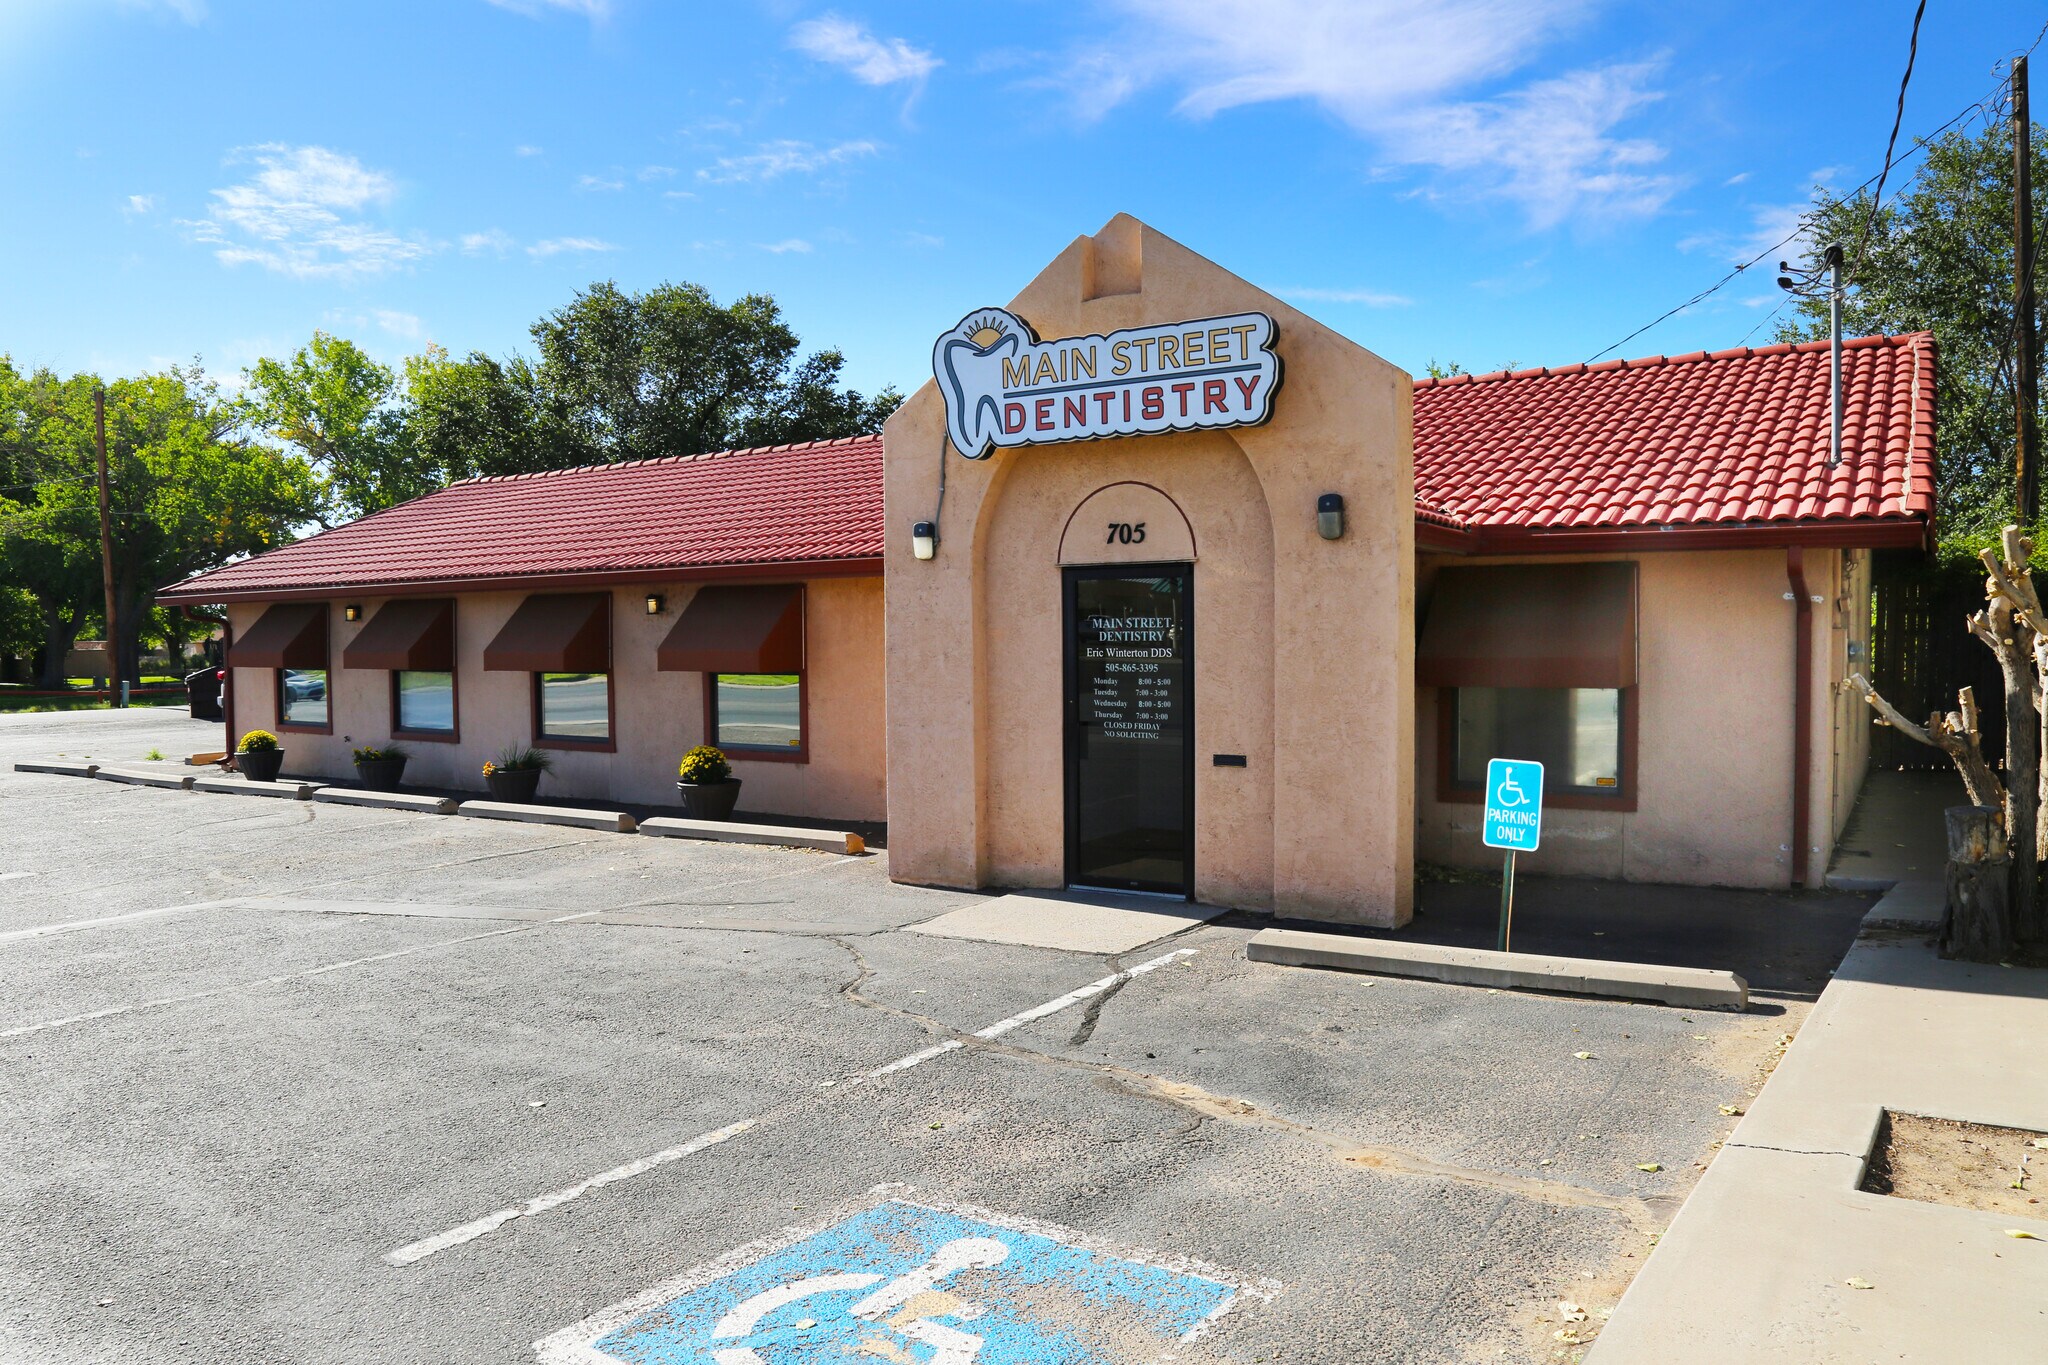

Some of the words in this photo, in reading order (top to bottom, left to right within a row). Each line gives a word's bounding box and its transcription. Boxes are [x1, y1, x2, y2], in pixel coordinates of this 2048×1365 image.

[1002, 345, 1096, 389] MAIN
[1111, 324, 1257, 375] STREET
[1004, 375, 1261, 434] DENTISTRY
[1107, 522, 1145, 544] 705
[1092, 618, 1123, 628] MAIN
[1126, 617, 1171, 628] STREET
[1099, 631, 1165, 641] DENTISTRY
[1086, 647, 1104, 657] Eric
[1106, 648, 1148, 657] Winterton
[1151, 648, 1172, 658] DDS
[1105, 663, 1158, 672] 505-865-3395
[1093, 677, 1118, 686] Monday
[1157, 678, 1171, 686] 5:00
[1094, 688, 1118, 697] Tuesday
[1093, 699, 1128, 708] Wednesday
[1094, 711, 1123, 720] Thursday
[1103, 721, 1132, 729] CLOSED
[1134, 722, 1161, 730] FRIDAY
[1116, 731, 1159, 739] SOLICITING
[1487, 808, 1537, 826] PARKING
[1496, 825, 1526, 842] ONLY
